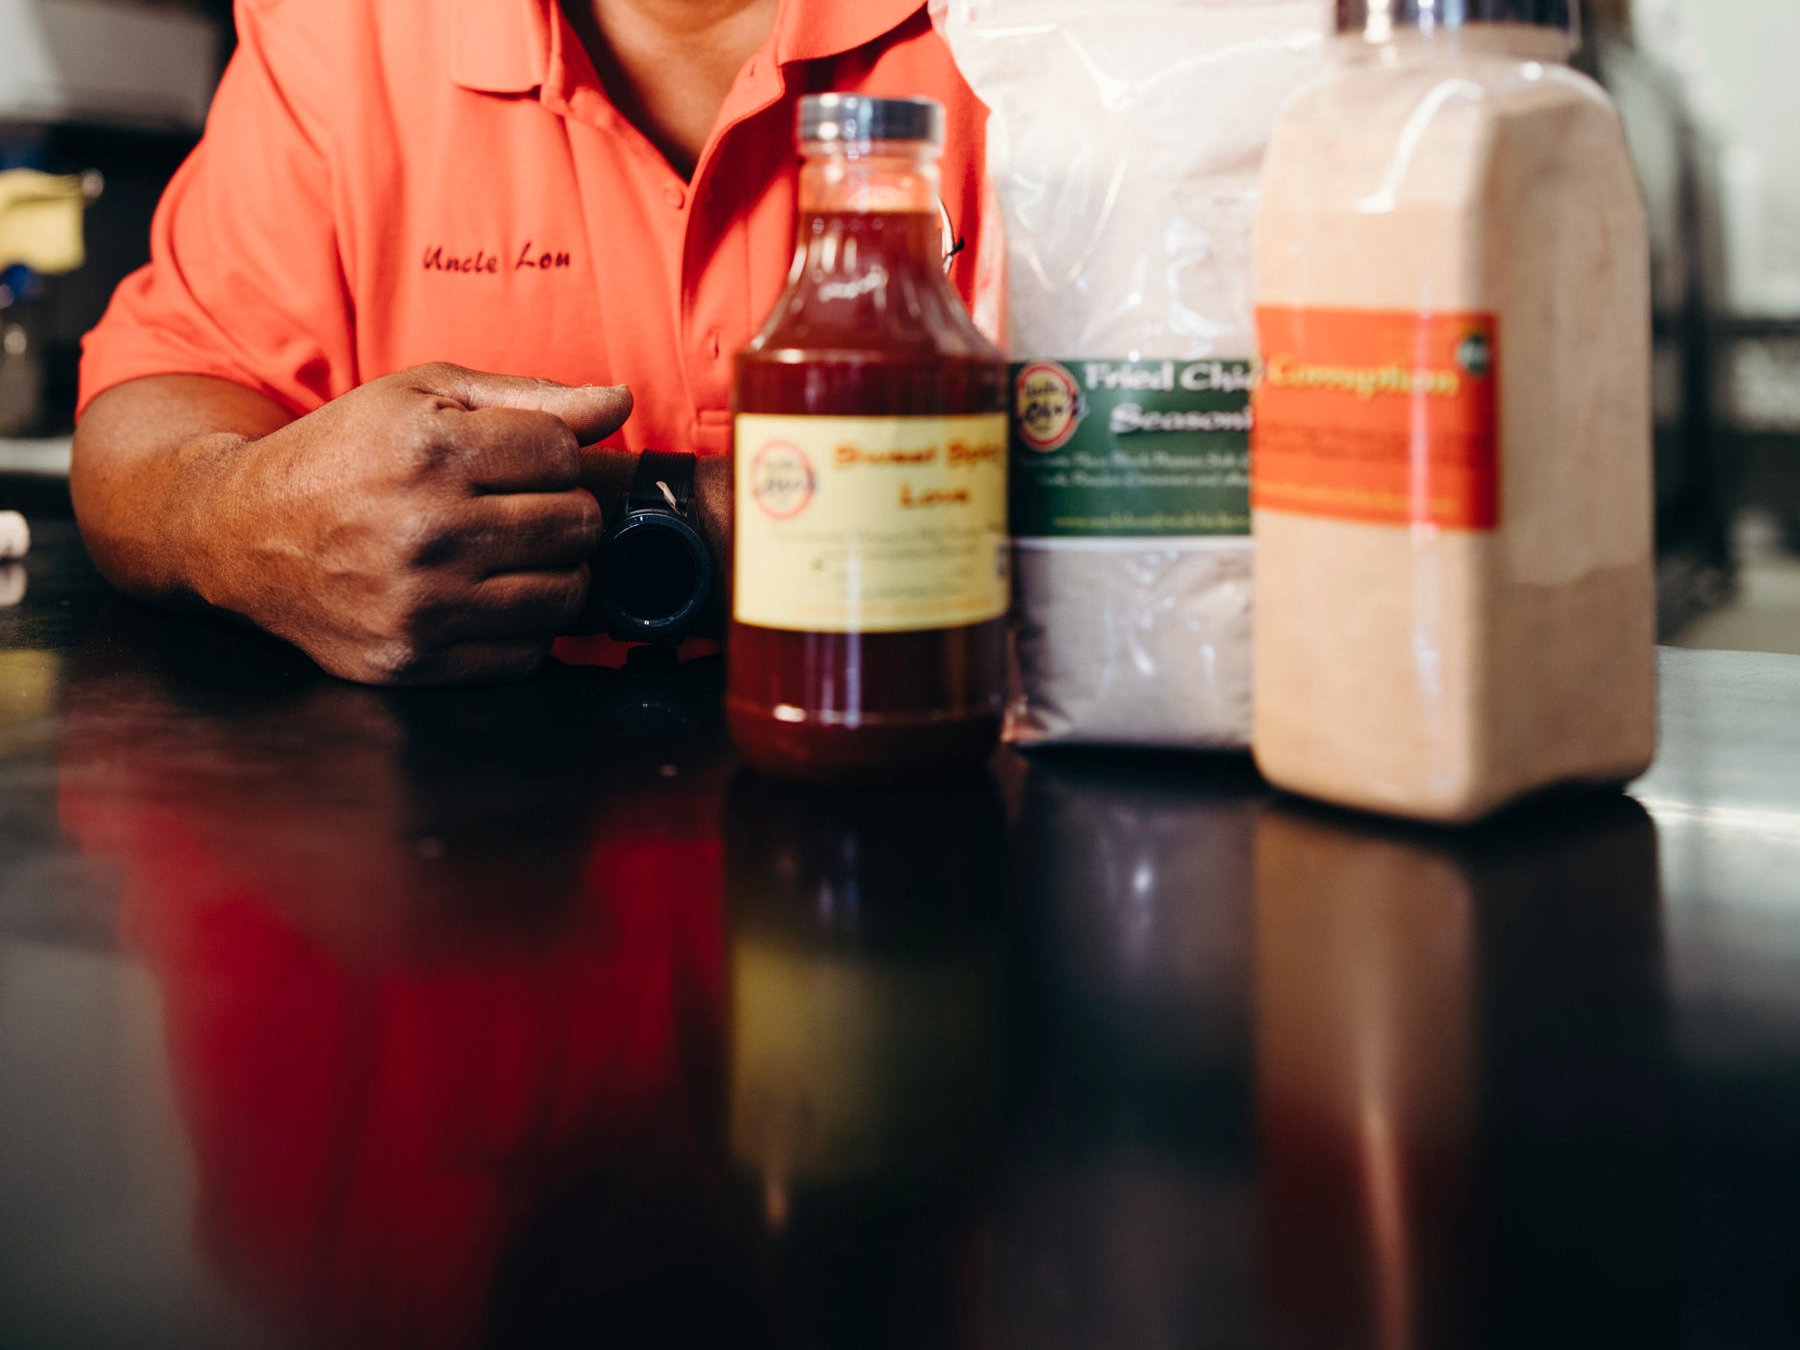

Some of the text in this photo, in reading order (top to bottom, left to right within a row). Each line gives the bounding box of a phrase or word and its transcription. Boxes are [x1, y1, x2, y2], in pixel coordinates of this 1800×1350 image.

[423, 242, 570, 273] Uncle Lou
[1083, 361, 1175, 391] Fried
